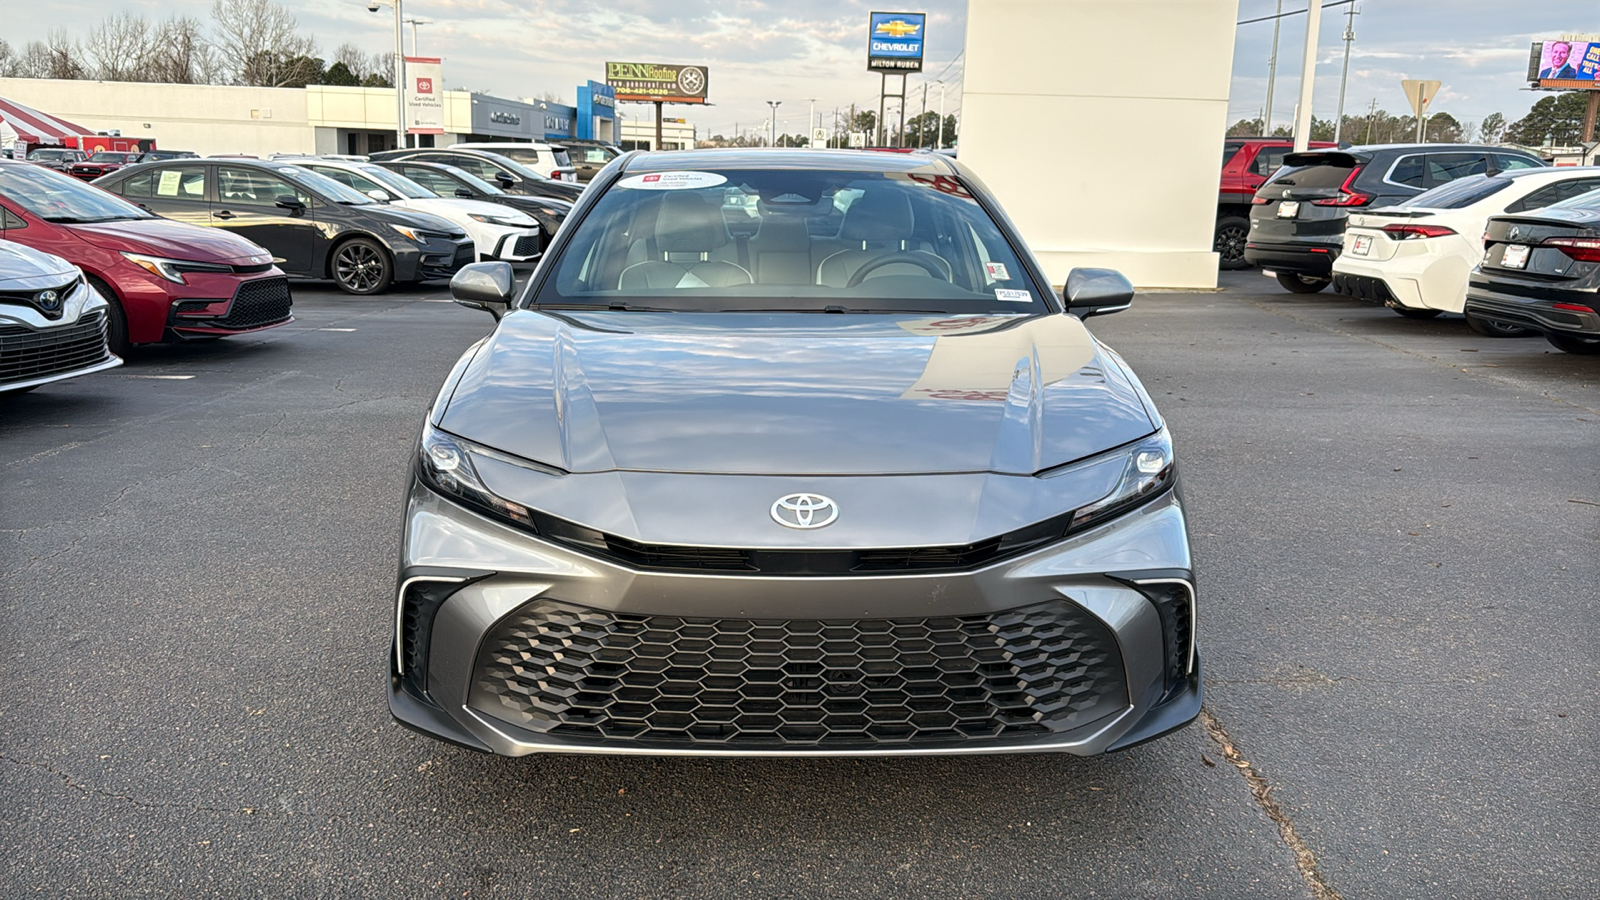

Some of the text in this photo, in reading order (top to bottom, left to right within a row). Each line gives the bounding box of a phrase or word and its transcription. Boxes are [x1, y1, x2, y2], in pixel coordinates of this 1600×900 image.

[872, 42, 920, 52] CHEVROLET
[608, 62, 676, 82] PENN Roofing
